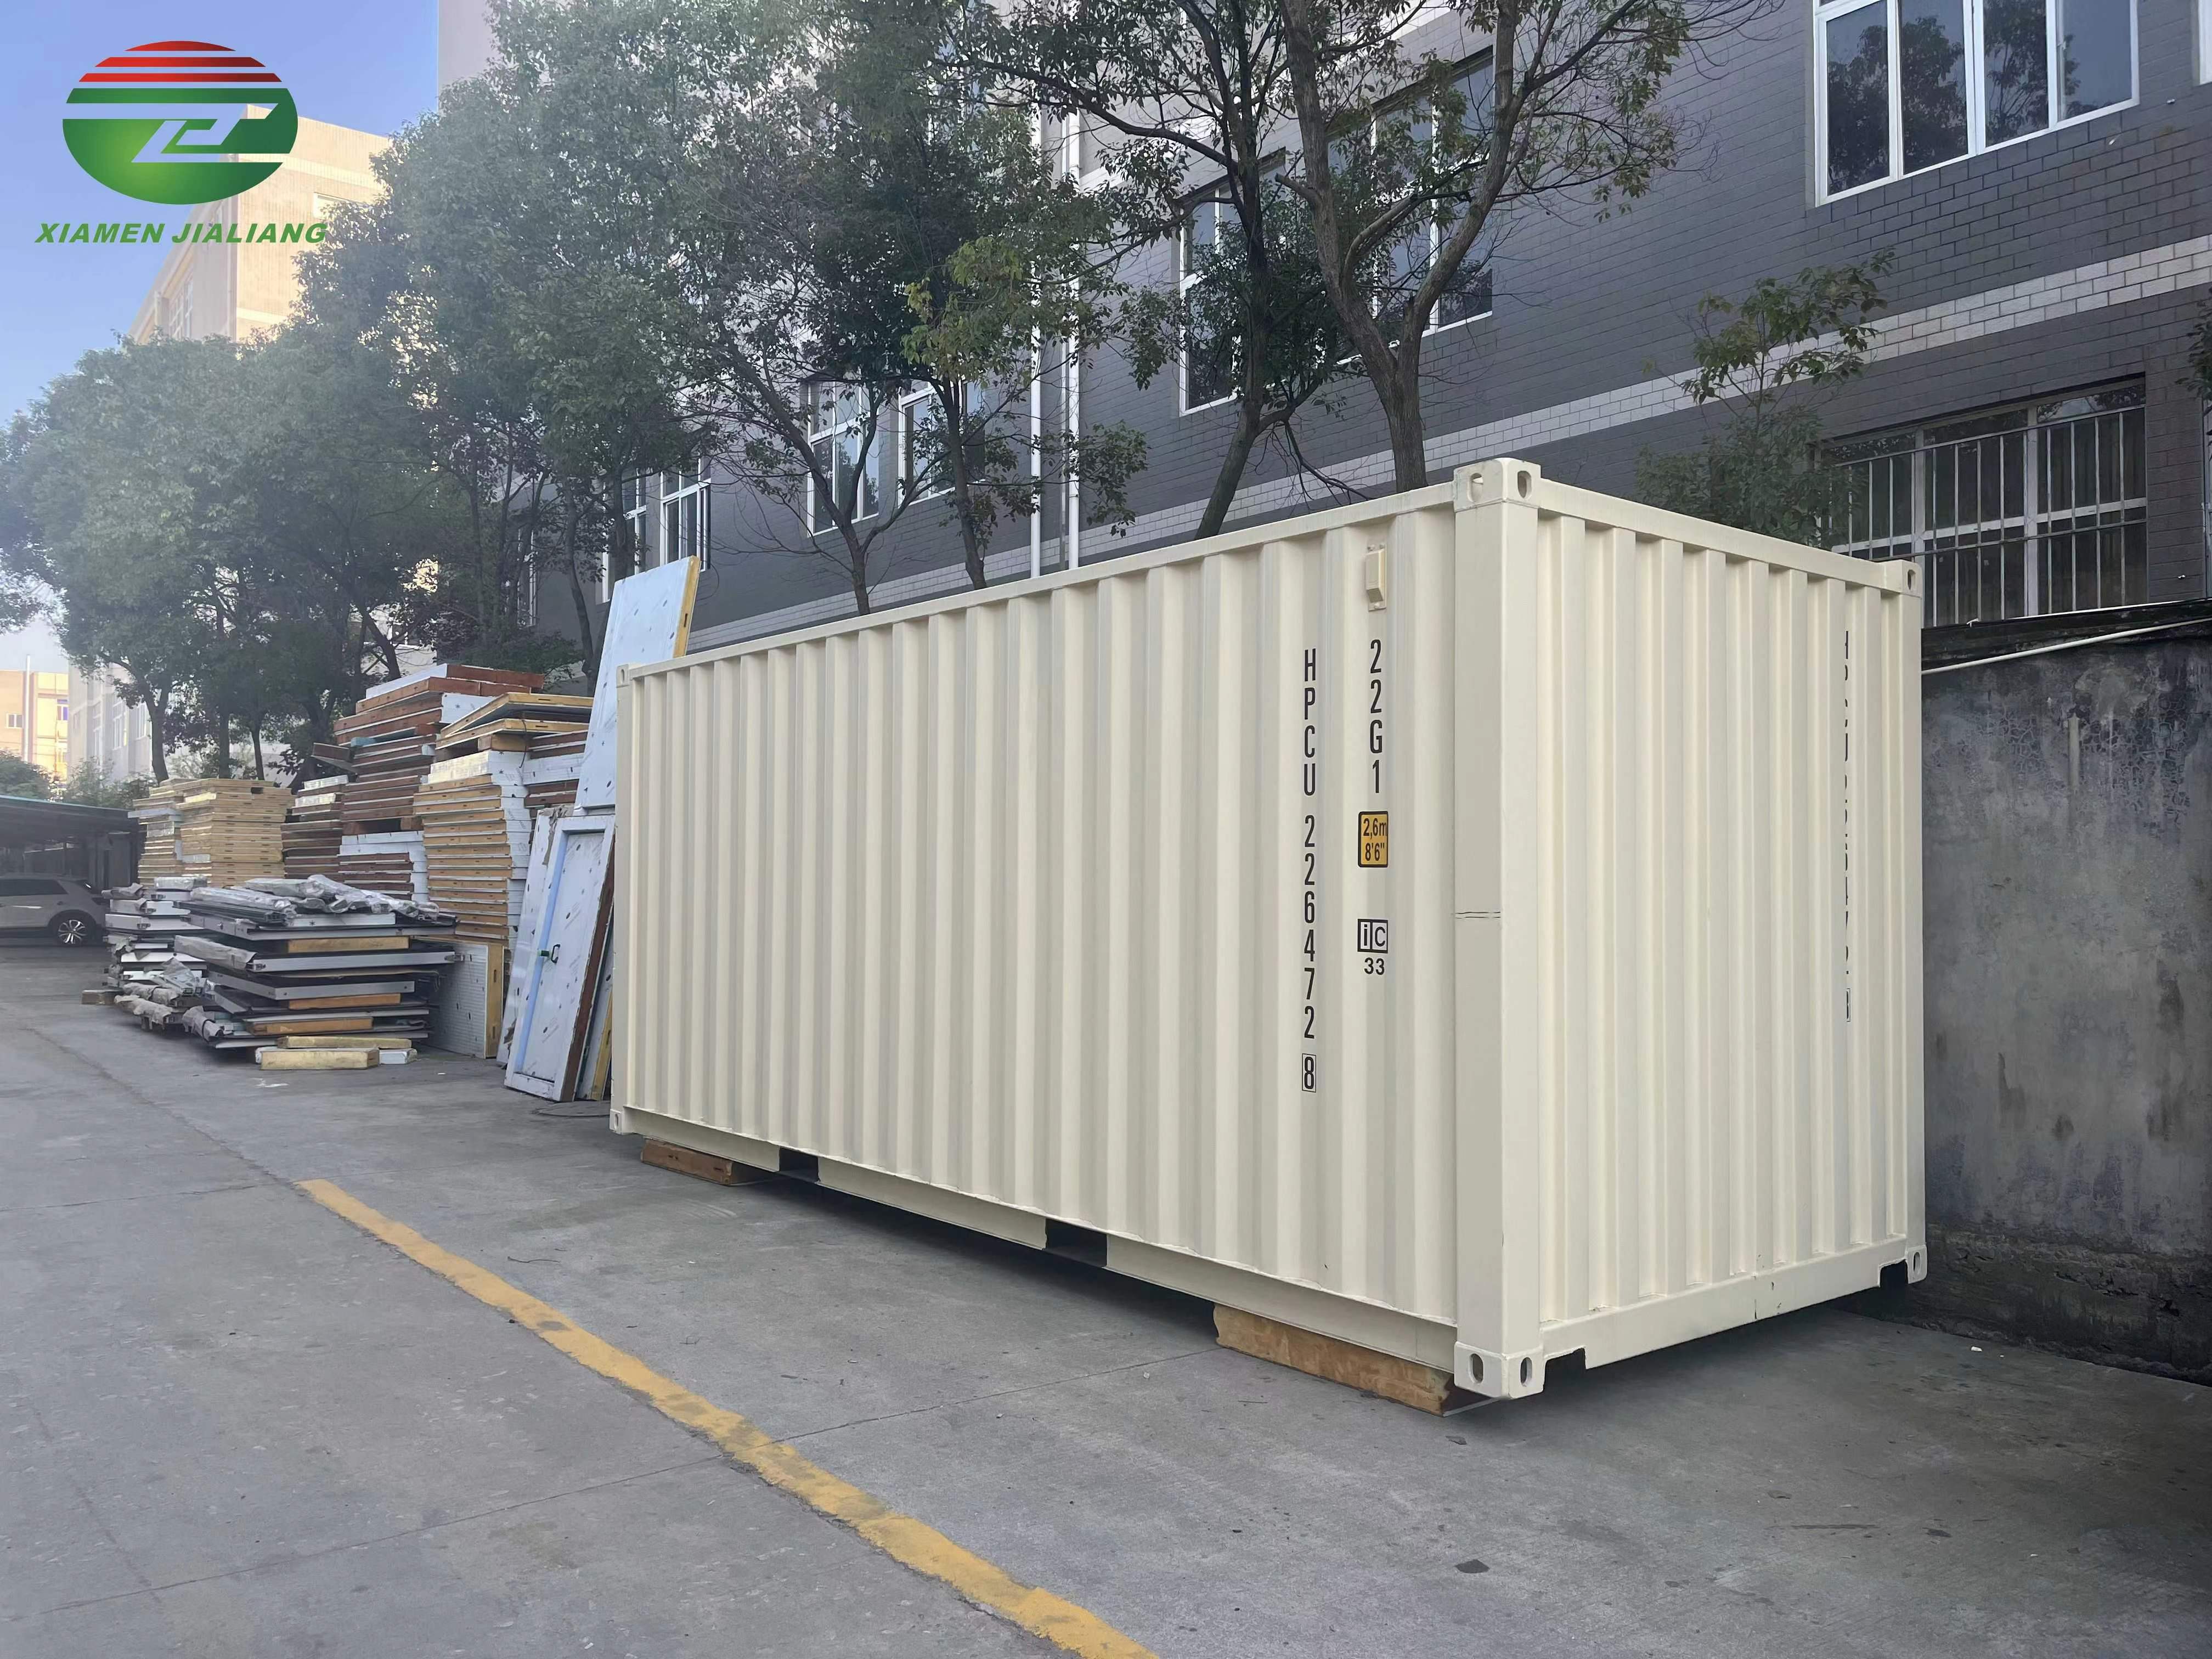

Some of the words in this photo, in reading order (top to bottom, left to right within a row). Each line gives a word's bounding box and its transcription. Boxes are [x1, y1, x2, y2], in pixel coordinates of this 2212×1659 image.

[1304, 648, 1316, 796] HPCU
[1370, 639, 1383, 794] 22G1
[1304, 815, 1316, 1039] 226472
[1364, 957, 1385, 975] 33
[1304, 1056, 1314, 1090] 8
